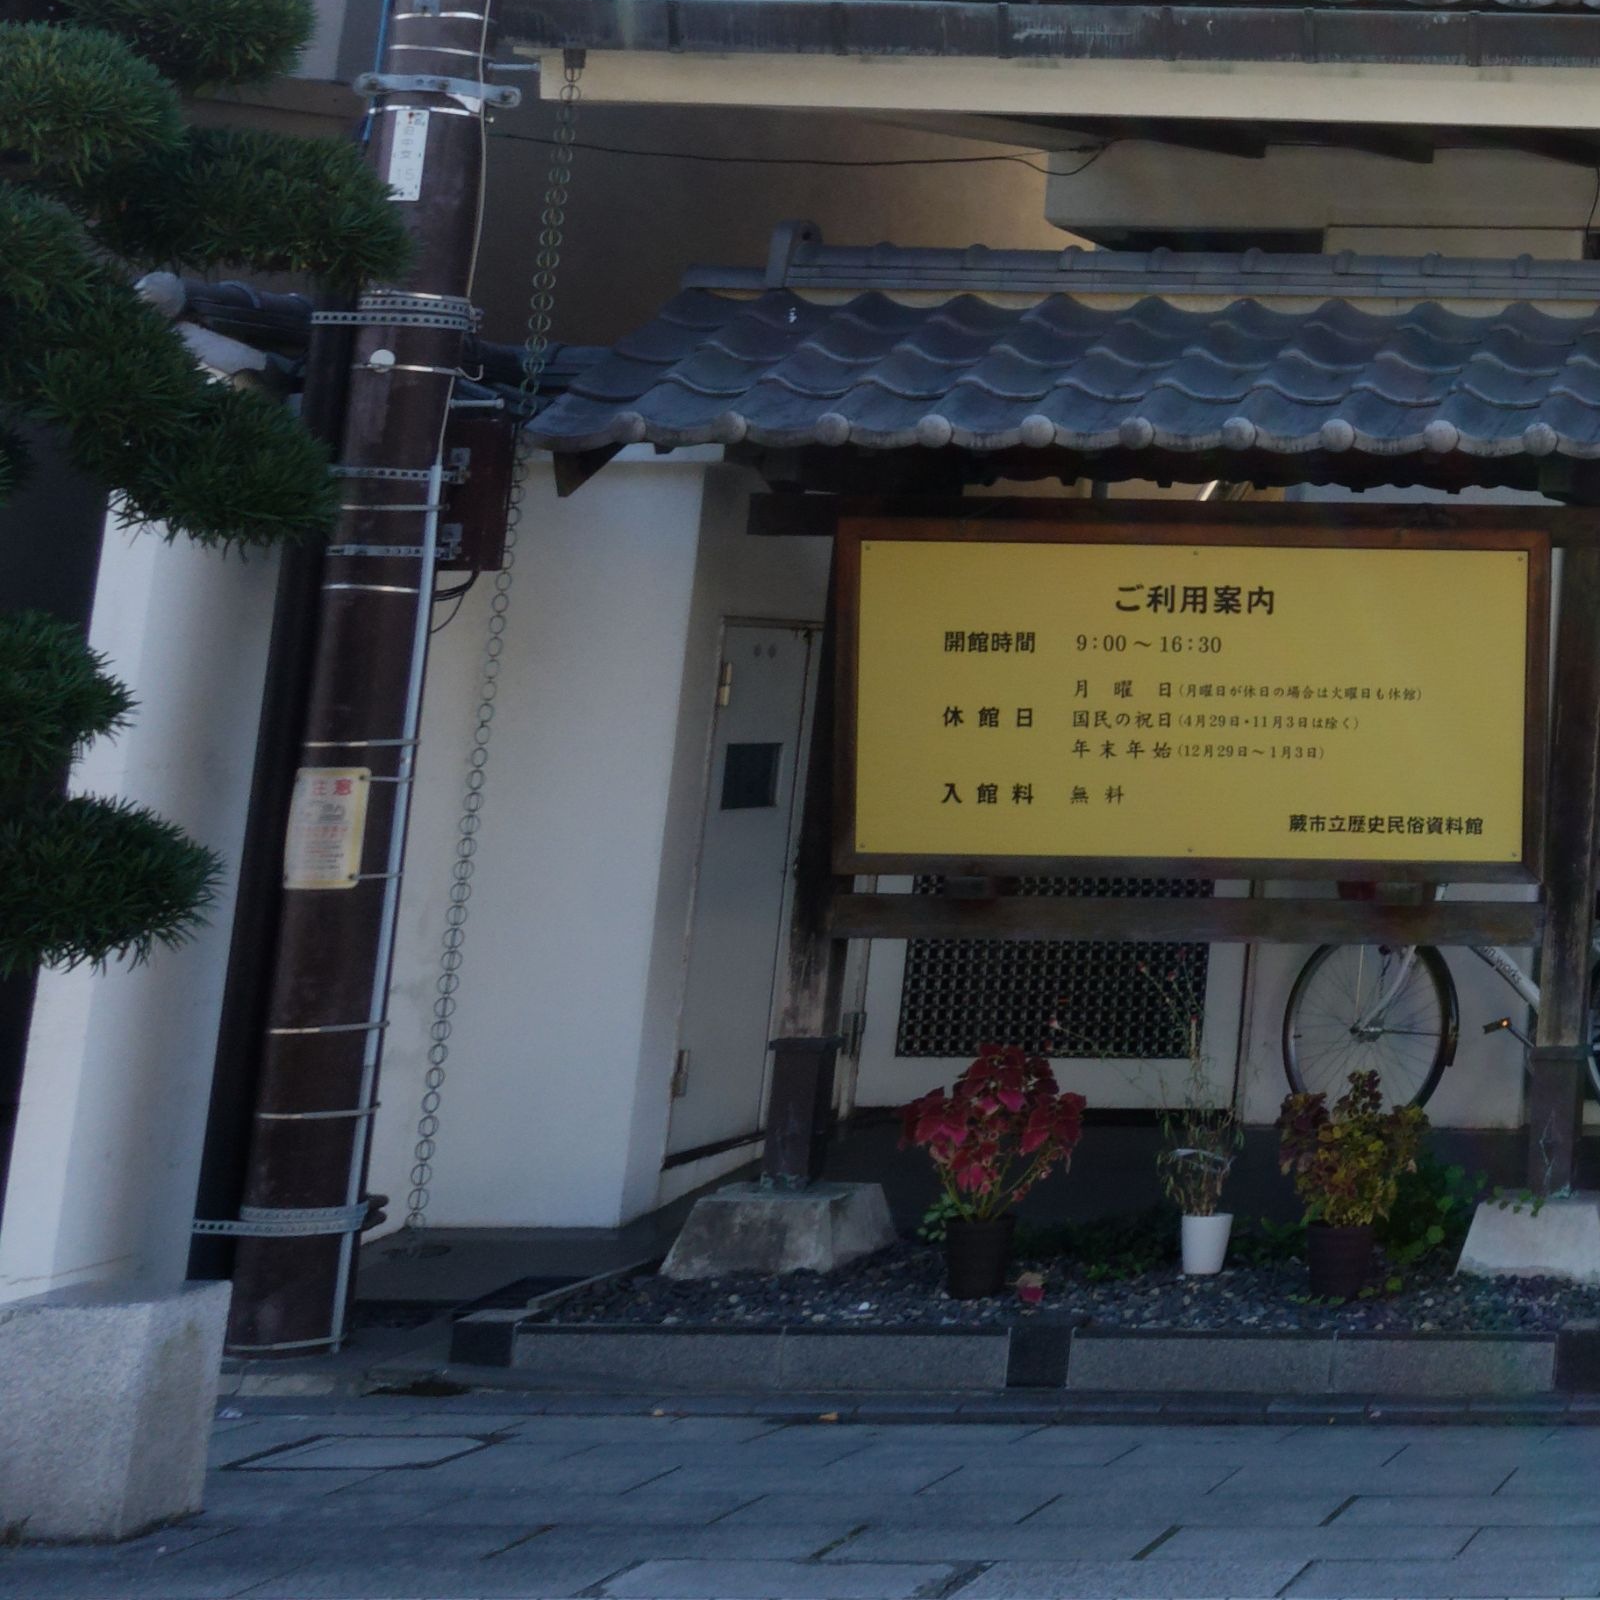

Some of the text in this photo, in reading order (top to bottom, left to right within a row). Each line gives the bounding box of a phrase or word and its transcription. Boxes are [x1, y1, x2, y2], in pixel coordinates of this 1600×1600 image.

[1114, 584, 1276, 616] ご利用案内
[943, 631, 1037, 654] 開館時間
[943, 706, 1035, 729] 休館日
[1072, 709, 1174, 730] 国民の祝日
[1071, 739, 1174, 761] 年末年始
[941, 782, 1126, 806] 入館料 無料
[1289, 813, 1485, 837] 蕨市立歴史民俗資料館
